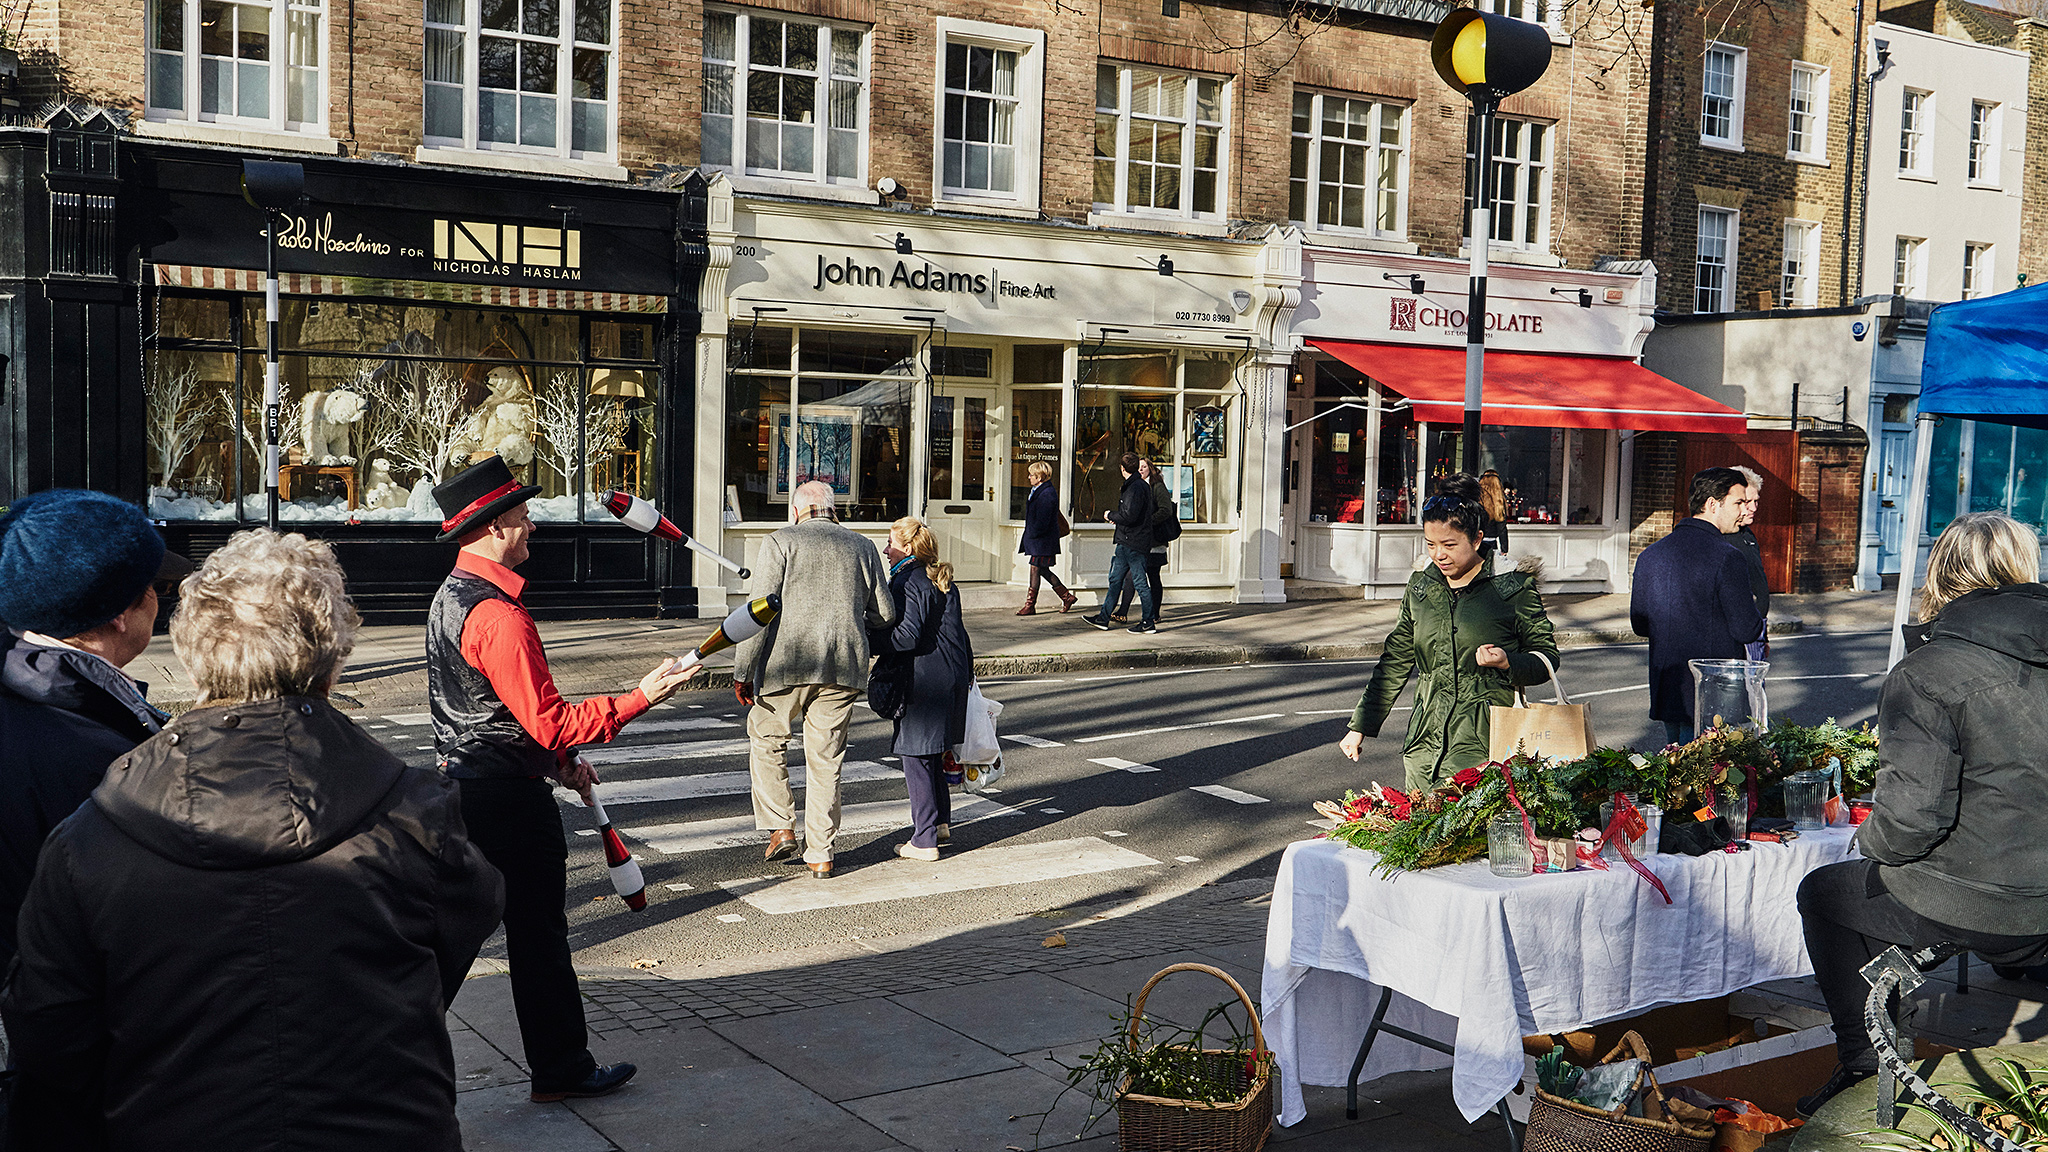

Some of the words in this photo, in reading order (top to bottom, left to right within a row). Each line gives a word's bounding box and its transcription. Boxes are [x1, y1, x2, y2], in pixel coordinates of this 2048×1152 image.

[315, 212, 391, 255] Moschino
[400, 248, 424, 258] FOR
[736, 245, 756, 257] 200
[433, 261, 510, 276] NICHOLAS
[523, 267, 581, 280] HASLAM
[813, 254, 886, 290] John
[889, 260, 988, 294] Adams
[999, 280, 1031, 298] Fine
[1032, 282, 1055, 299] Art
[1175, 311, 1191, 320] 020
[1192, 312, 1211, 322] 7730
[1212, 313, 1231, 323] 8999
[1419, 307, 1543, 333] CHOOLATE
[1020, 430, 1029, 438] Oil
[1029, 430, 1056, 441] Paintings
[1019, 441, 1056, 450] Watercolours
[1016, 452, 1037, 462] Antique
[1038, 453, 1059, 461] Frames
[1530, 731, 1551, 740] THE
